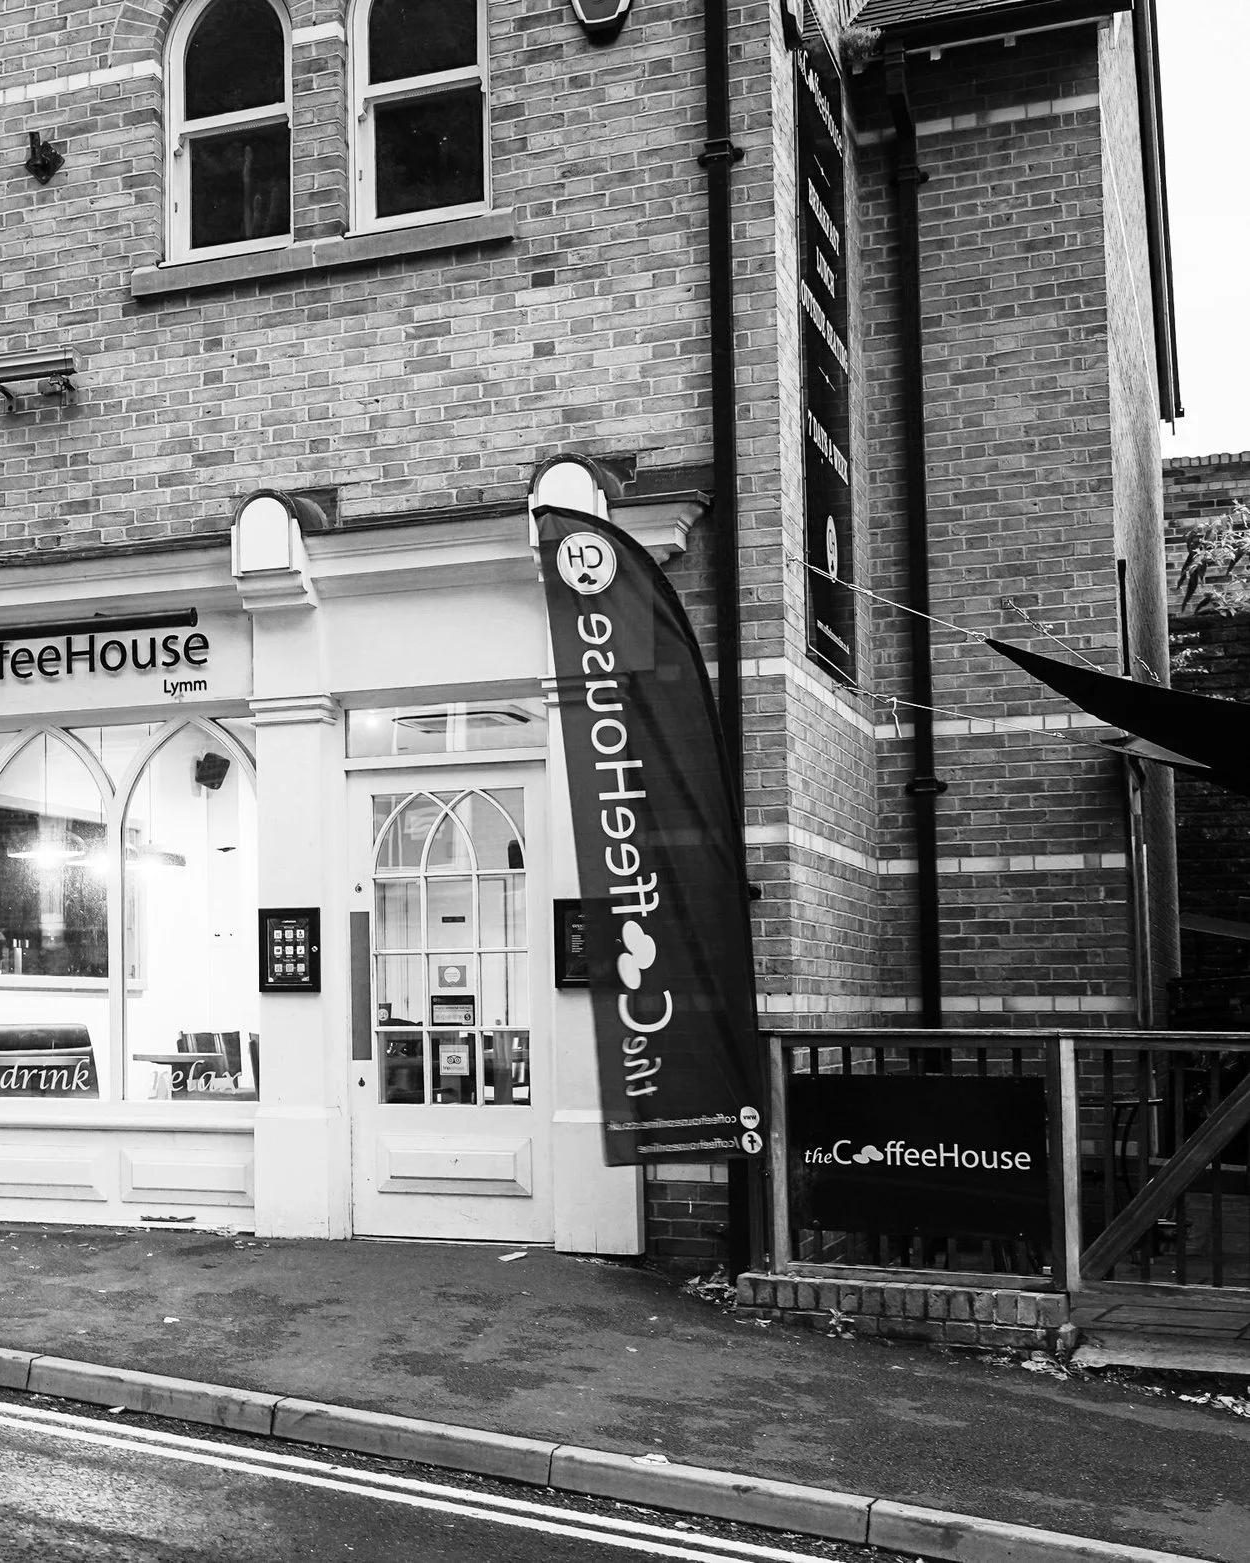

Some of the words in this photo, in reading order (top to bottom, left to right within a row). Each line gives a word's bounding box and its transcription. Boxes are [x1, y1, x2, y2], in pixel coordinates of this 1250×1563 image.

[163, 679, 208, 697] Lymm
[0, 1056, 92, 1091] drink
[148, 1060, 243, 1095] relax
